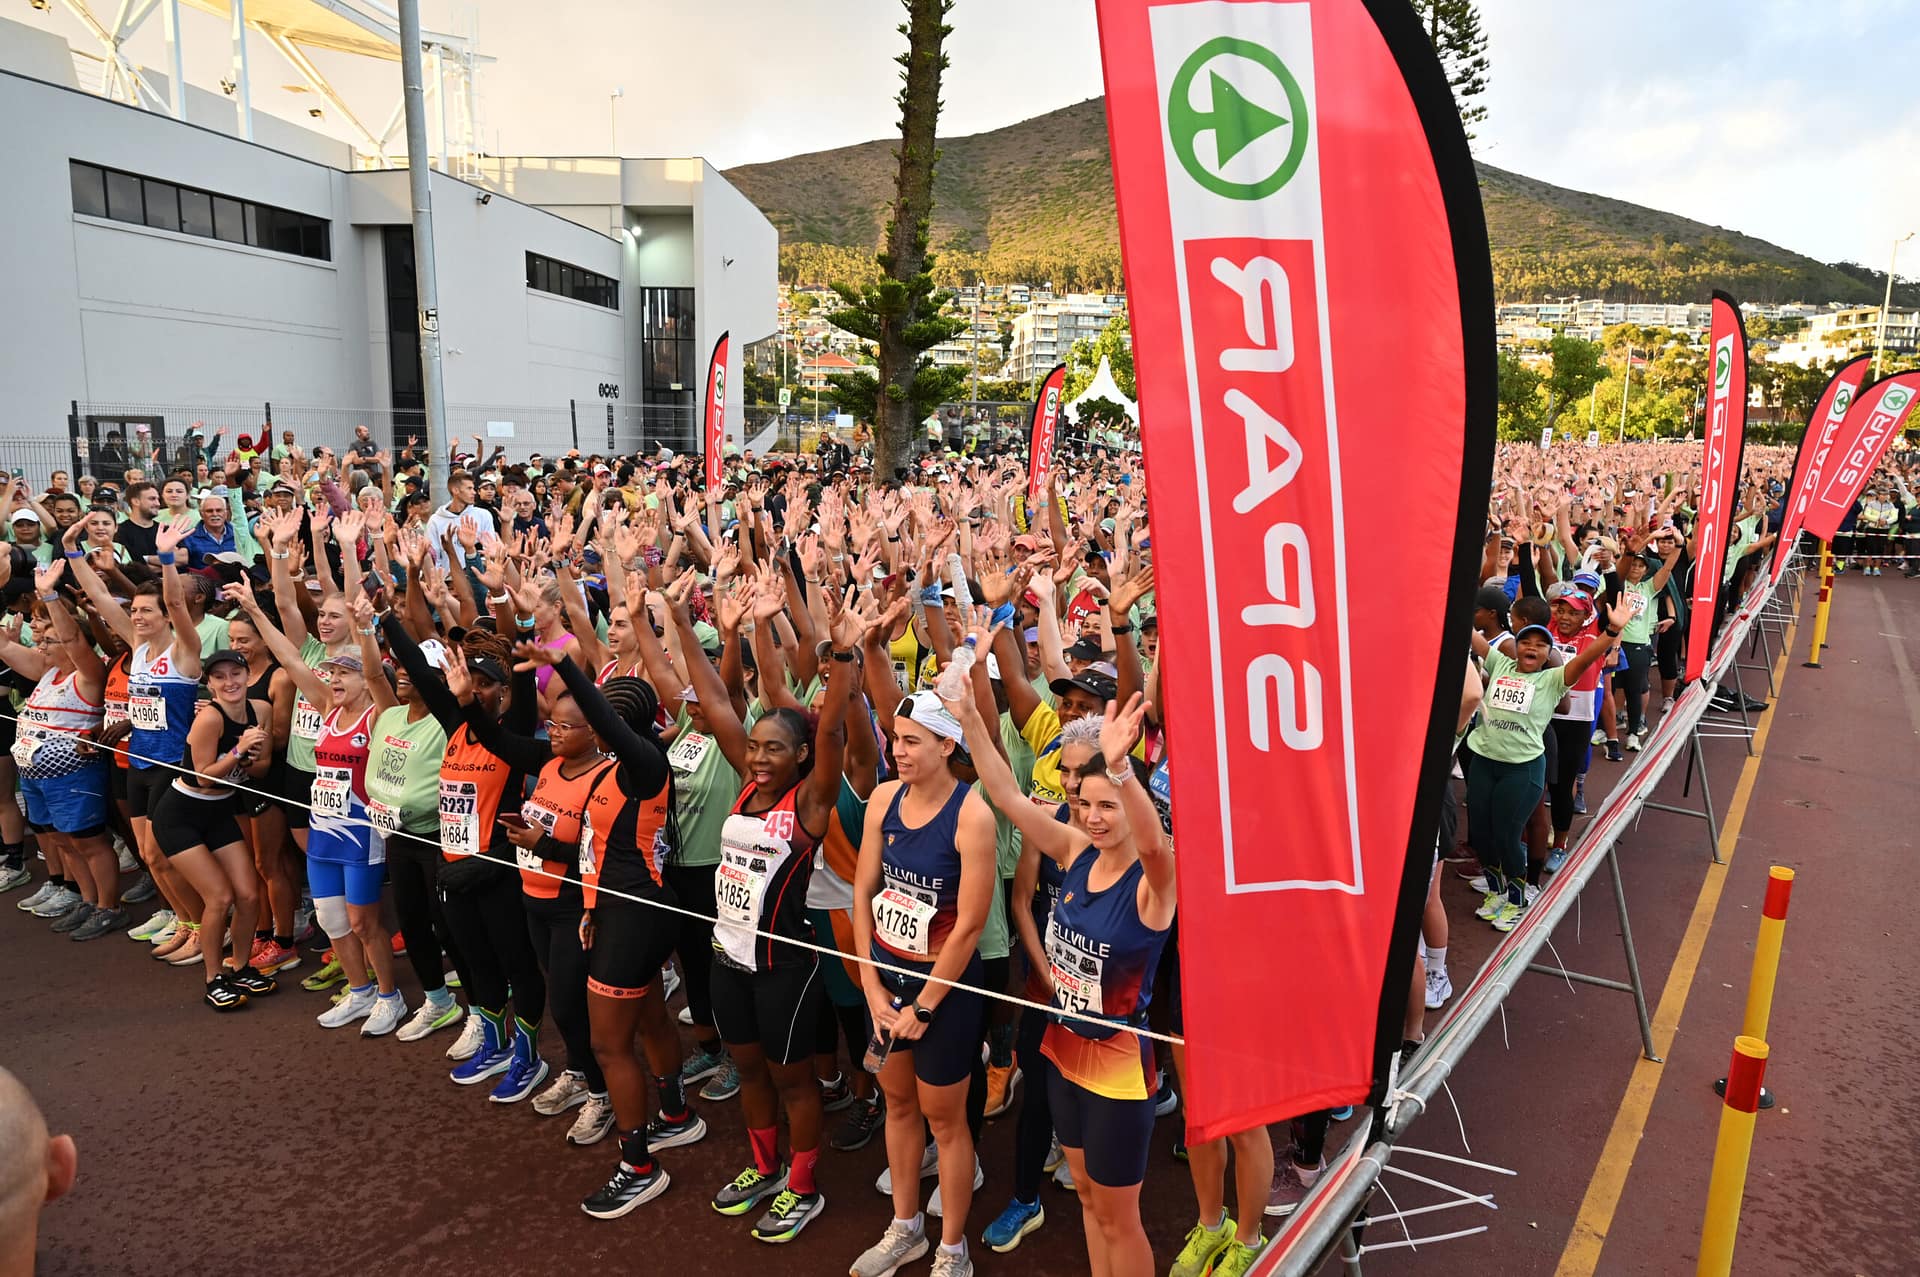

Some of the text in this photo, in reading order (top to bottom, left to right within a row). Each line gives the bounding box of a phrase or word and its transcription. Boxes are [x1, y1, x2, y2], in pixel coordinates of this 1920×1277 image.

[713, 408, 722, 490] PAR
[1037, 418, 1053, 486] SPAR
[1840, 414, 1892, 486] SPAR
[150, 658, 169, 676] 45
[1492, 687, 1525, 705] A1963
[132, 706, 159, 722] A1906
[296, 711, 321, 731] A114
[315, 751, 363, 764] EST COAST
[482, 763, 497, 772] AC
[376, 766, 407, 786] Women's
[313, 789, 343, 809] A1063
[763, 812, 793, 840] 45
[724, 867, 748, 882] SPAR
[881, 862, 944, 890] ELLVILLE
[717, 878, 751, 911] A1852
[889, 892, 917, 909] SPAR
[1047, 883, 1062, 898] BE
[877, 903, 919, 940] A1785
[1052, 921, 1111, 959] ELLVILLE
[1055, 968, 1080, 991] SPAR
